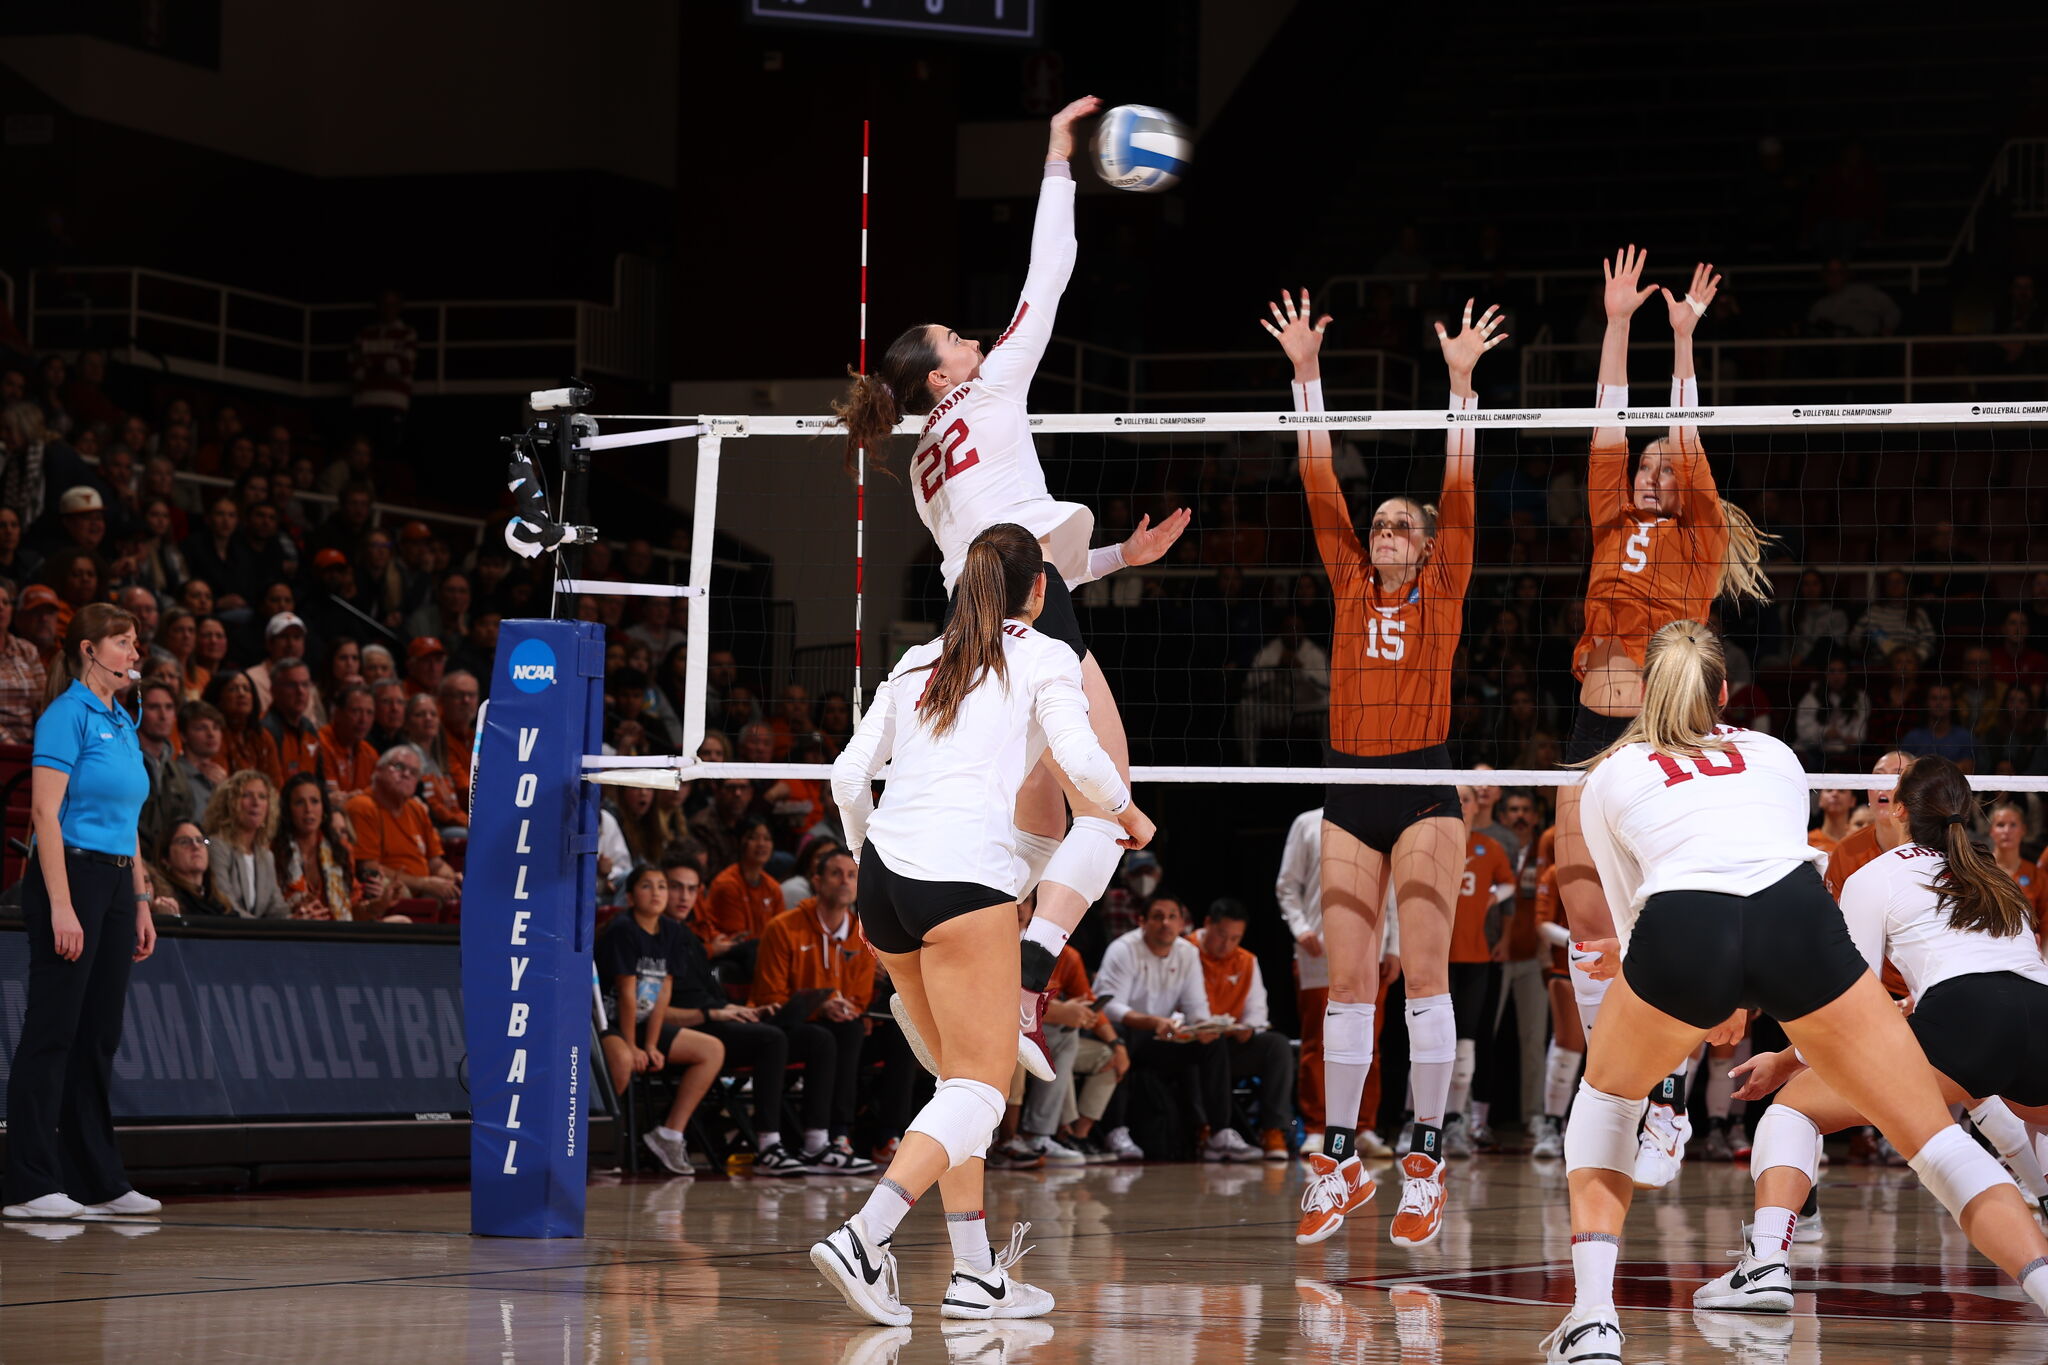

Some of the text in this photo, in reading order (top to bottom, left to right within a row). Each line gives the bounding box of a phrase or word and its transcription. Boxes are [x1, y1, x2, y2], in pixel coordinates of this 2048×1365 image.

[1456, 412, 1542, 422] VOLLEYBALL CHAMPIONSHIP
[1627, 410, 1715, 419] VOLLEYBALL CHAMPIONSHIP
[1802, 408, 1892, 417] VOLLEYBALL CHAMPIONSHIP
[1982, 406, 2020, 415] VOLLEYBALL
[1123, 416, 1206, 425] VOLLEYBALL CHAMPIONSHIP
[1288, 415, 1372, 424] VOLLEYBALL CHAMPIONSHIP
[917, 418, 980, 503] 22
[1621, 534, 1650, 574] 5
[1366, 618, 1406, 661] 15
[512, 664, 555, 681] NCAA
[1648, 742, 1747, 788] 10
[503, 727, 539, 1176] VOLLEYBALL
[569, 1045, 579, 1095] sports
